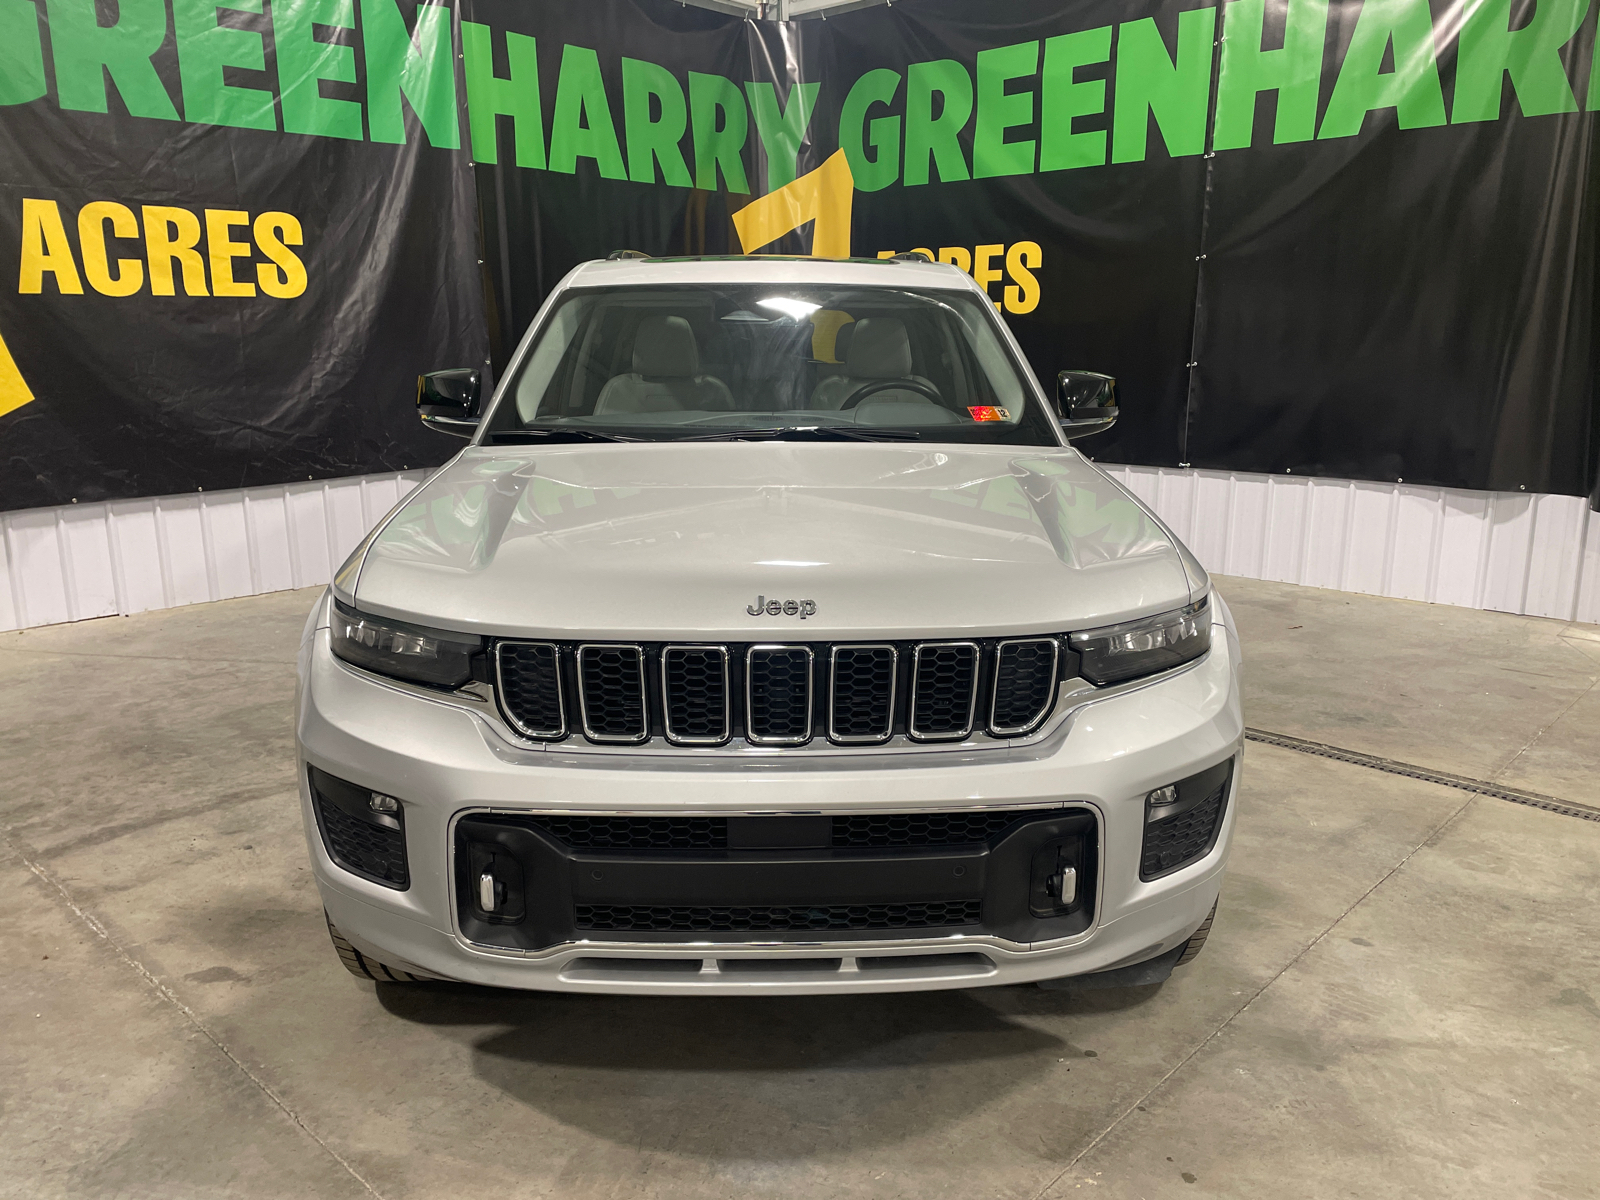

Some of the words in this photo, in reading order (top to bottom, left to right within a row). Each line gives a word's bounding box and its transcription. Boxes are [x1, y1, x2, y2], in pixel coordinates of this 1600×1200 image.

[0, 0, 461, 150] REEN
[461, 20, 821, 195] HARRY
[838, 6, 1217, 192] GREEN
[1213, 0, 1600, 151] HAR
[18, 198, 308, 299] ACRES
[746, 595, 817, 620] Jeep
